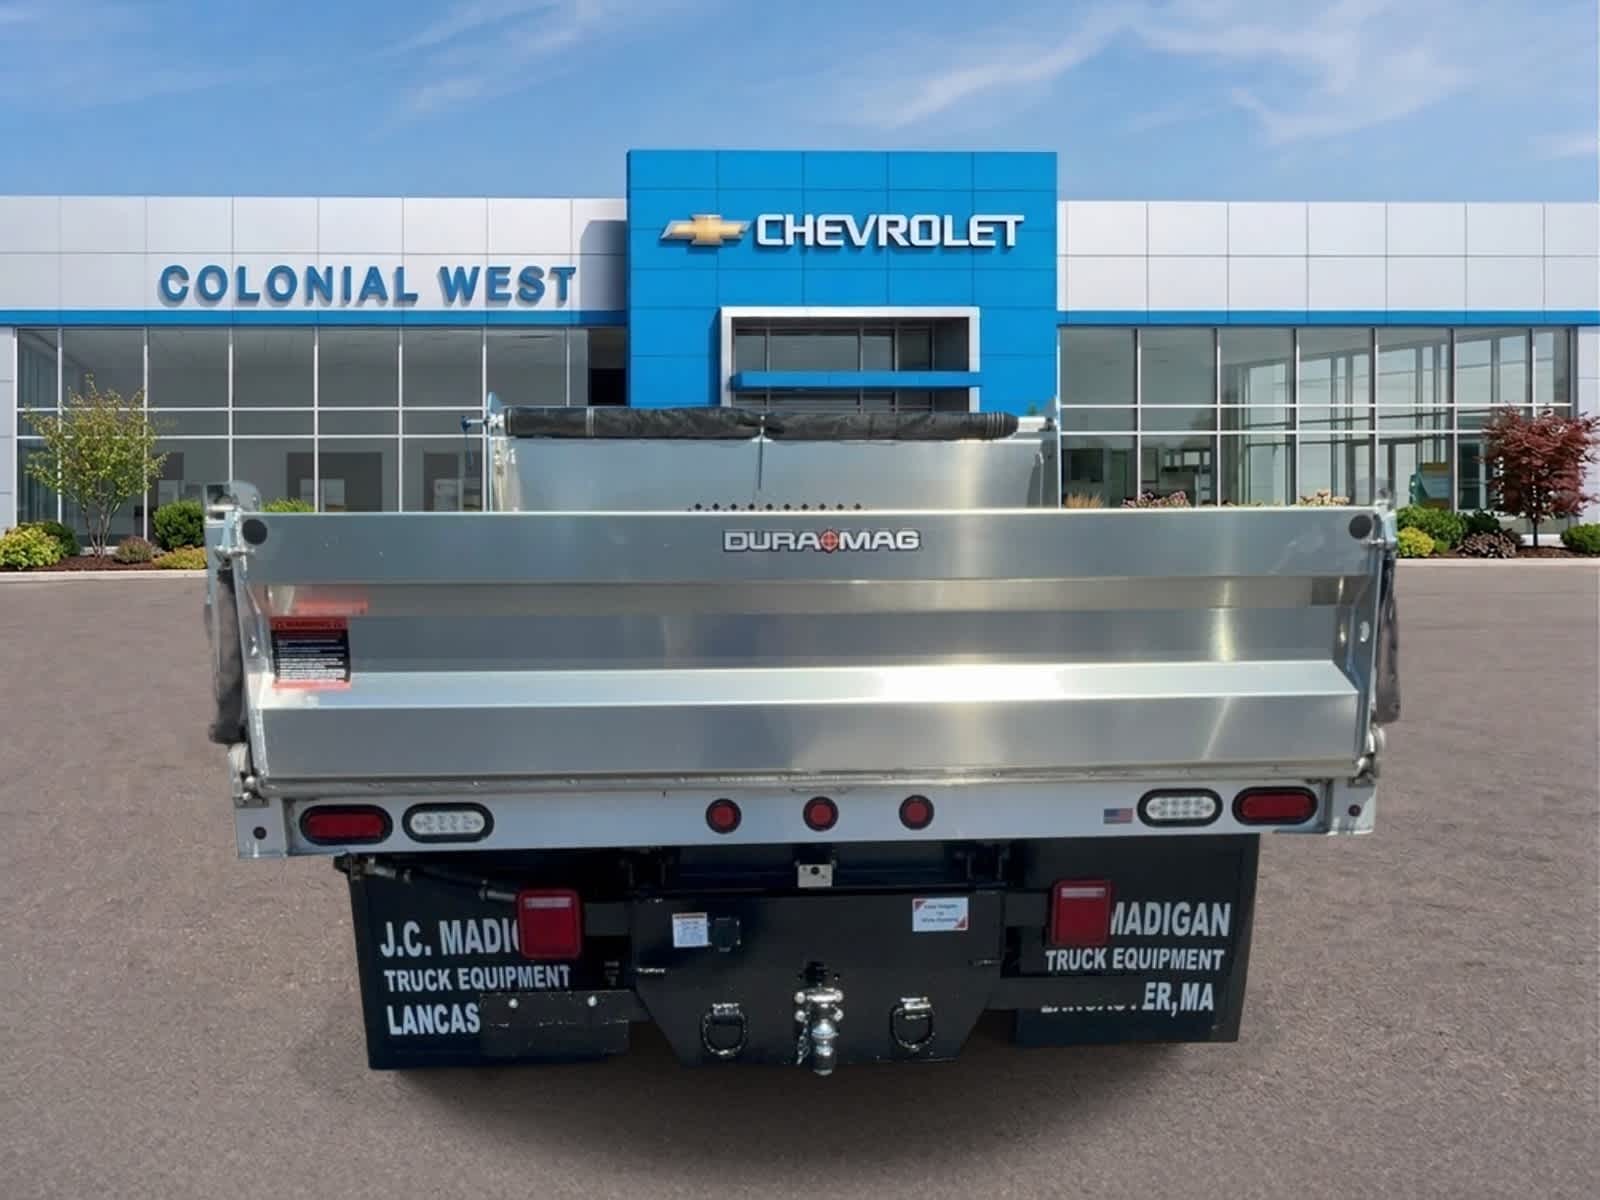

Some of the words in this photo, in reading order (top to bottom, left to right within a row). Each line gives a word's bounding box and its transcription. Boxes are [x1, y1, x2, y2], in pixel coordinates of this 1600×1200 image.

[756, 213, 1025, 247] CHEVROLET
[159, 264, 419, 302] COLONIAL
[439, 265, 577, 302] WEST
[380, 921, 432, 957] J.C.
[439, 918, 520, 955] MADI
[1045, 948, 1107, 971] TRUCK
[1112, 948, 1225, 971] EQUIPMENT
[384, 968, 453, 992] TRUCK
[458, 965, 571, 990] EQUIPMENT
